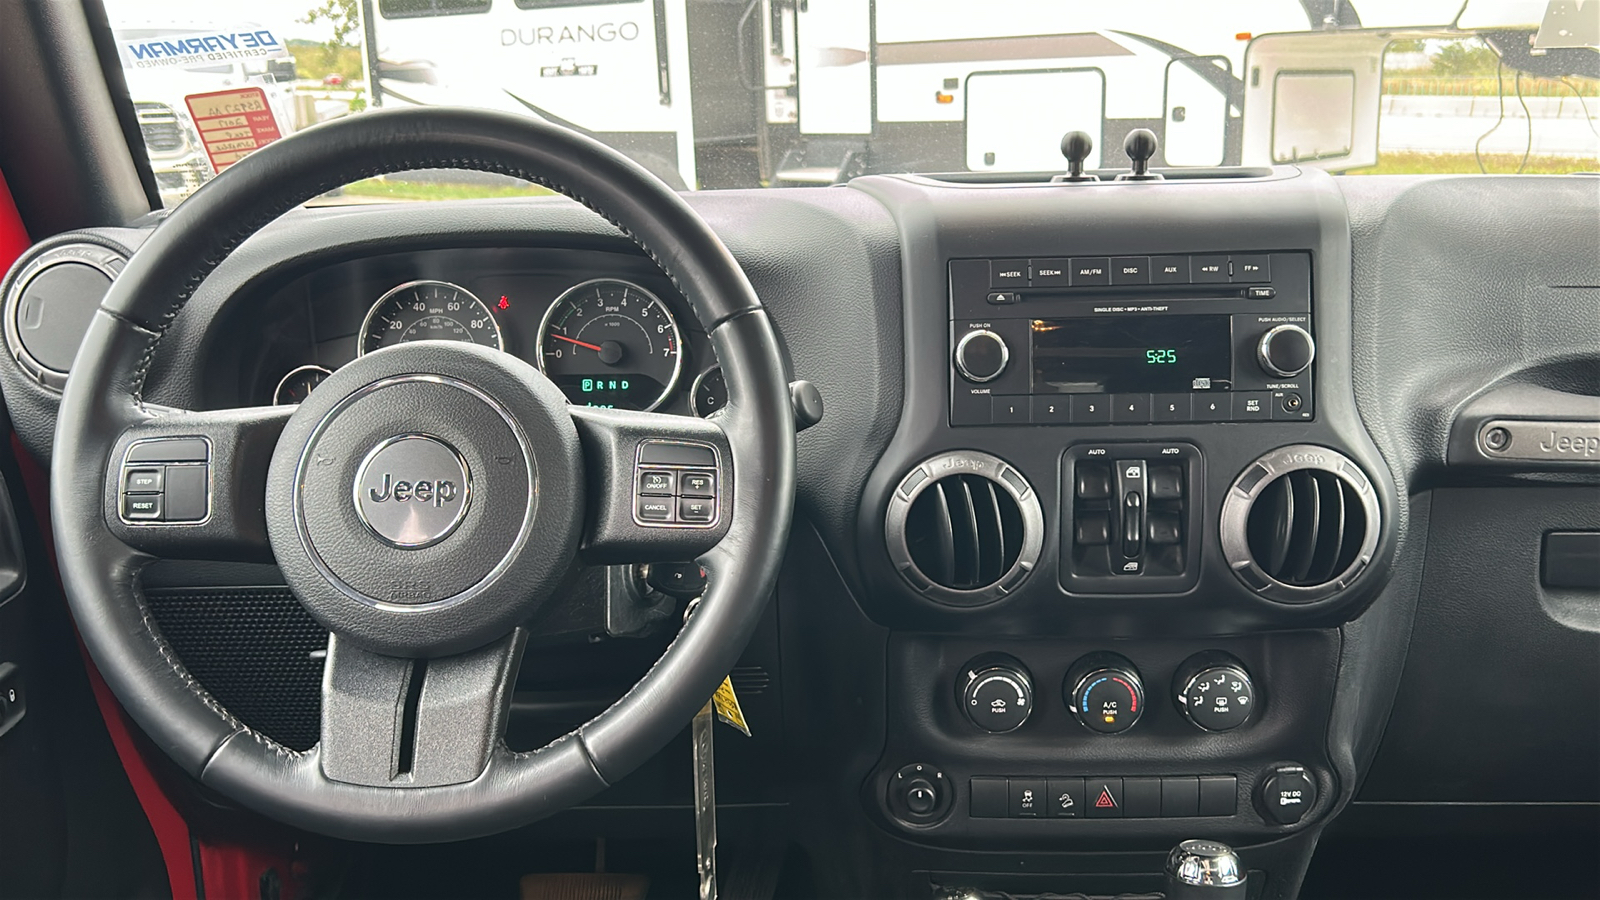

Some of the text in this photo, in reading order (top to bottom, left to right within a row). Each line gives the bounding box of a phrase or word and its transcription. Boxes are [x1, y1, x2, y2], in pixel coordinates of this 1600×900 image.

[501, 22, 639, 46] DURANGO
[413, 302, 426, 311] 40
[447, 302, 460, 311] 60
[597, 298, 604, 307] 3
[620, 298, 628, 307] 4
[576, 308, 583, 316] 2
[641, 308, 648, 317] 5
[390, 320, 403, 330] 20
[470, 320, 484, 329] 80
[657, 324, 664, 334] 6
[563, 327, 568, 335] 1
[555, 349, 563, 359] 0
[663, 348, 670, 358] 7
[1146, 350, 1177, 364] 5:25
[597, 381, 604, 389] R
[609, 381, 617, 389] N
[622, 381, 629, 389] D
[707, 396, 715, 405] C
[1540, 430, 1600, 457] Jeep
[368, 473, 457, 508] Jeep
[1103, 701, 1117, 709] A/C
